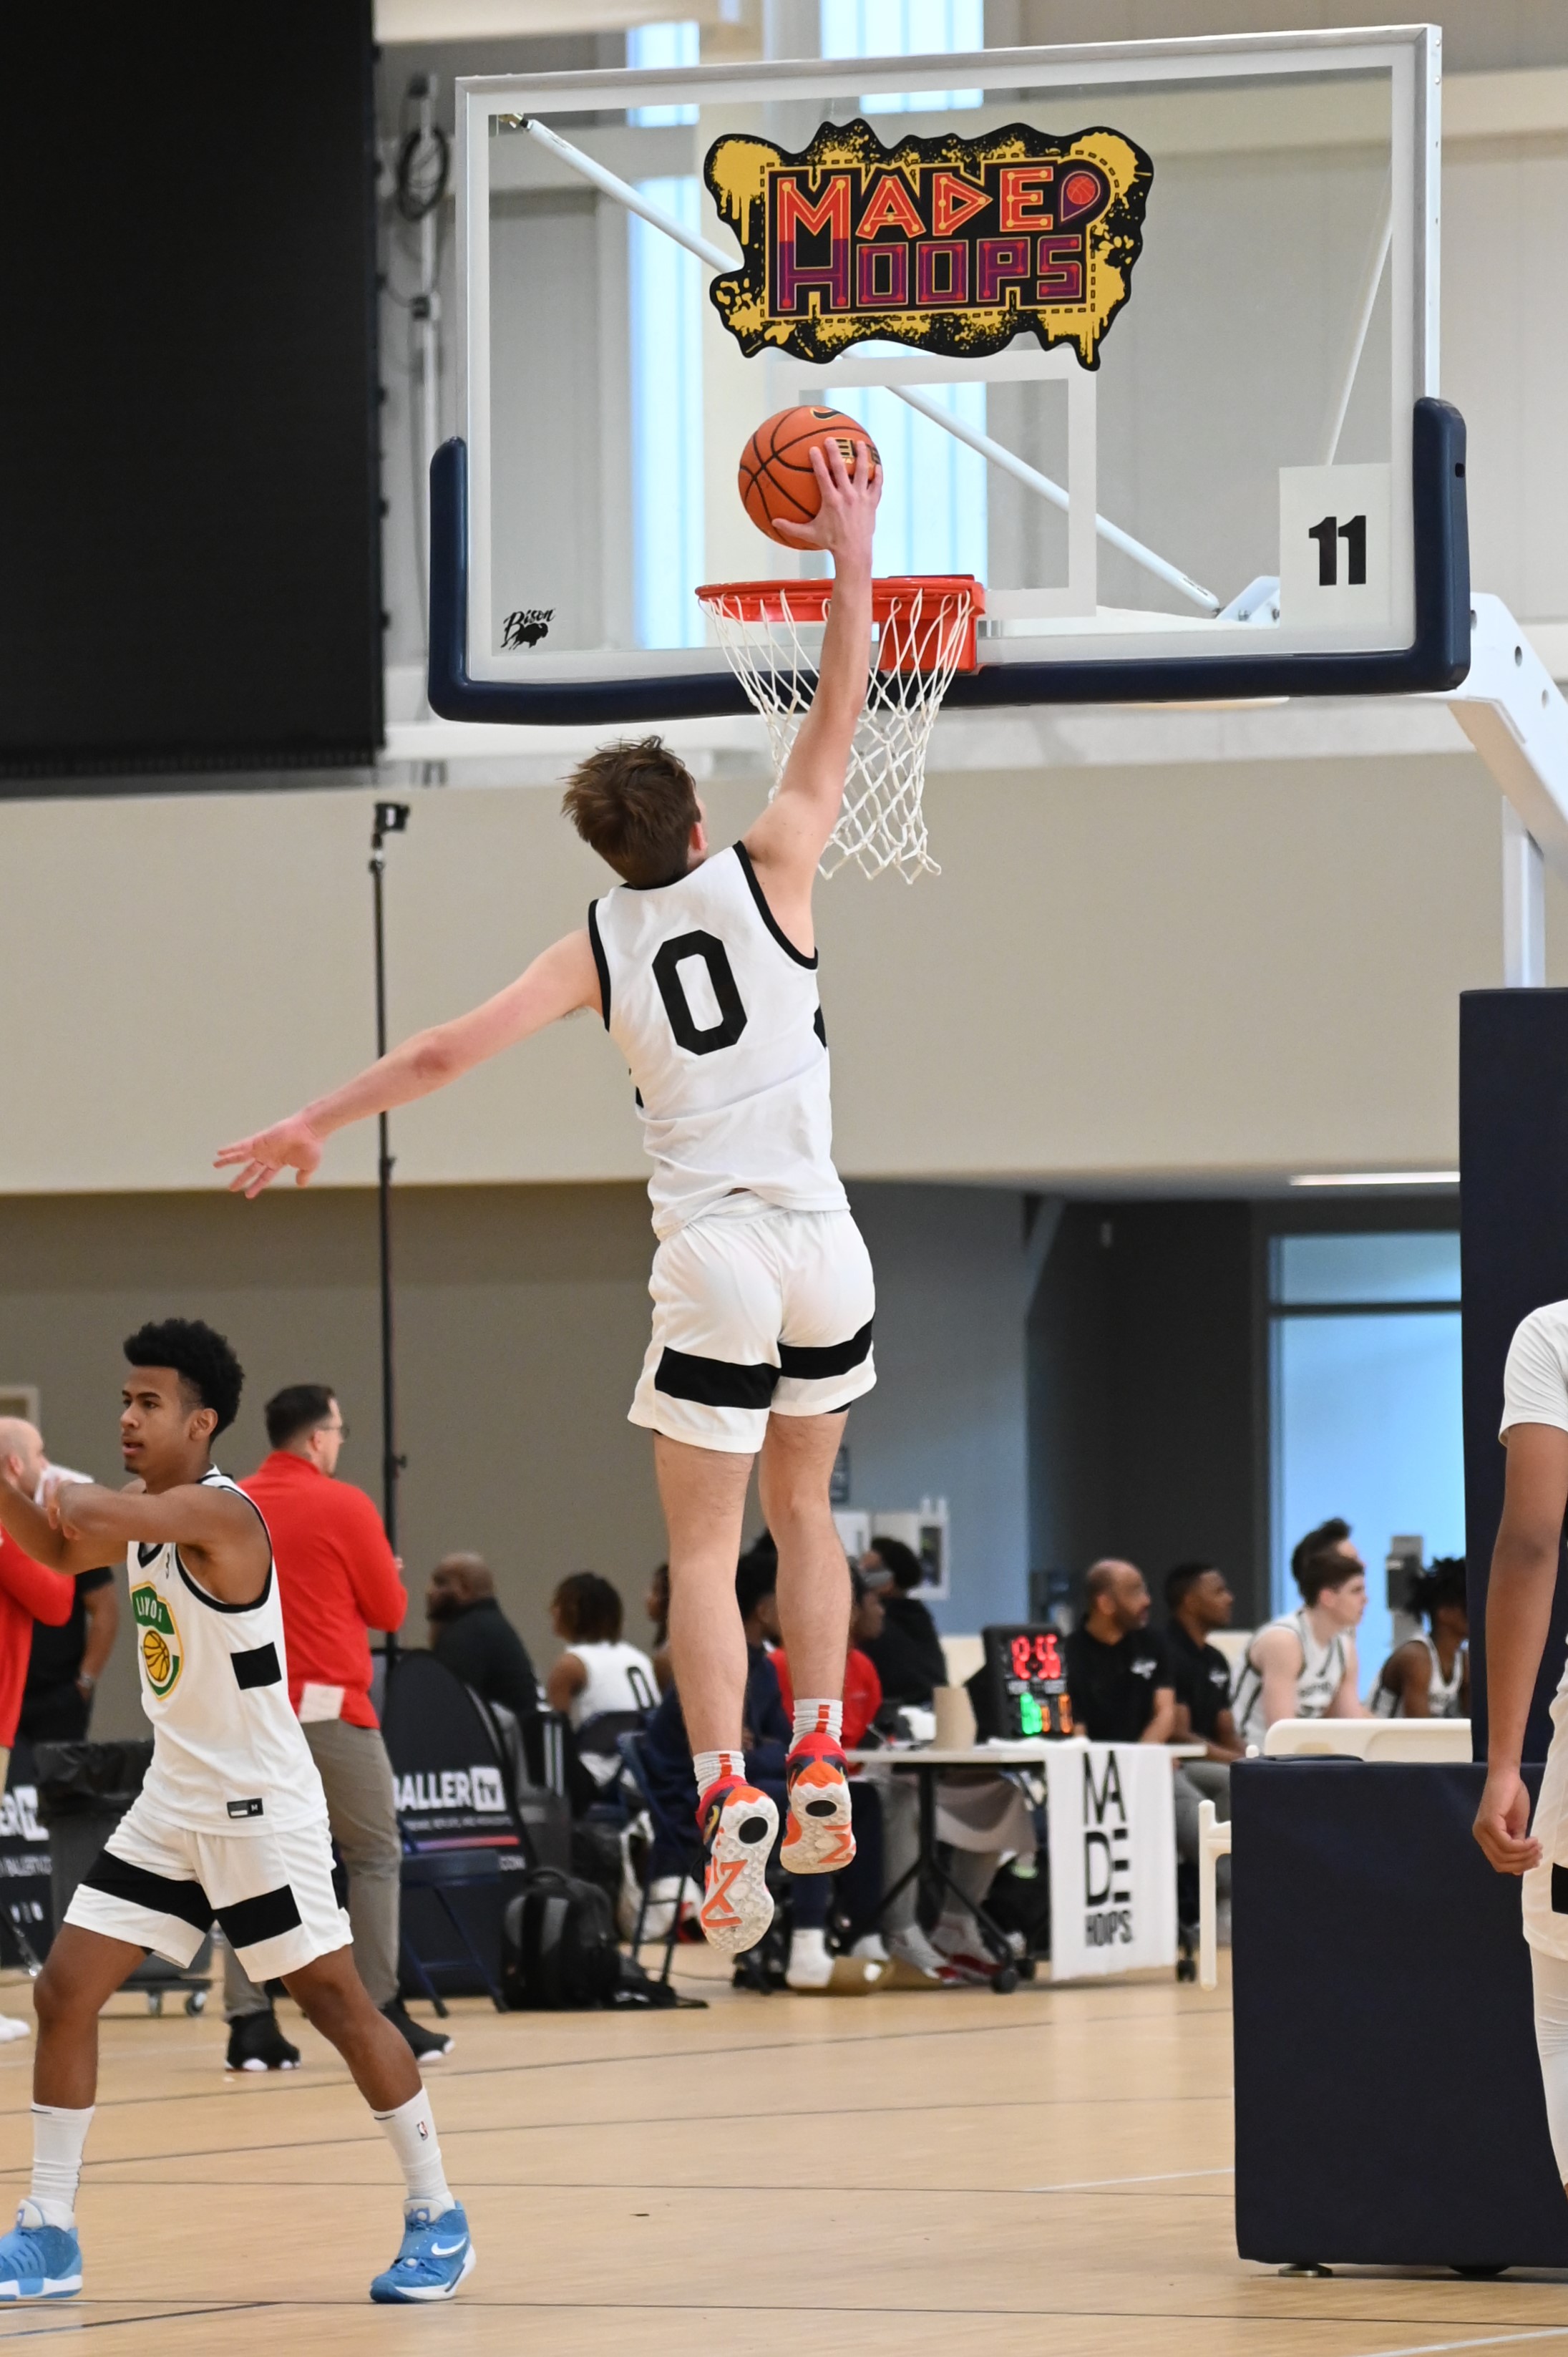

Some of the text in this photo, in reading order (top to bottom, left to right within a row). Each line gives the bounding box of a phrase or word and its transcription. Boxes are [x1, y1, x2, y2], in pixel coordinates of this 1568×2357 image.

[777, 166, 1053, 240] MADE
[777, 234, 1082, 311] HOOPS
[1309, 515, 1366, 586] 11
[500, 608, 557, 648] Bison
[652, 929, 748, 1056] 0
